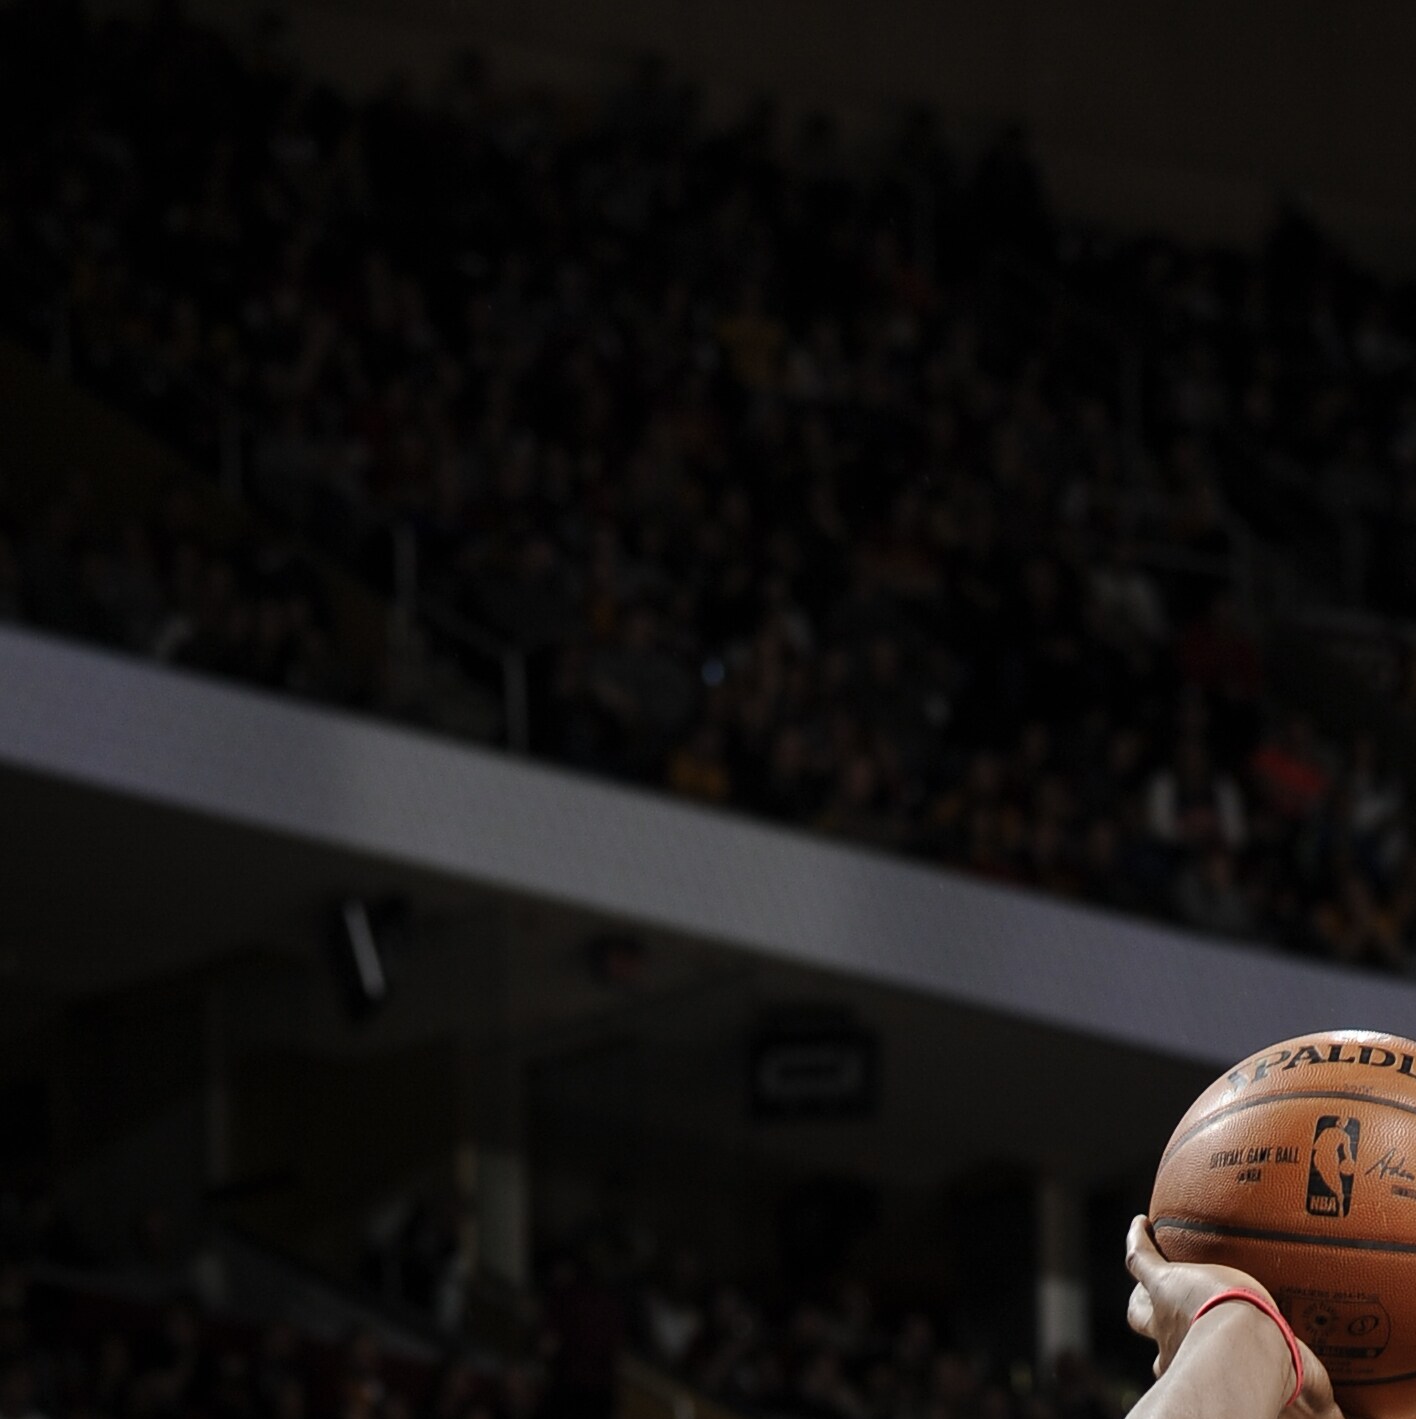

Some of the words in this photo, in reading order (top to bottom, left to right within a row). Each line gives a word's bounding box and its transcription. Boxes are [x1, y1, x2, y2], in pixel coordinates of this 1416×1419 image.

[1247, 1145, 1272, 1165] GAME
[1275, 1144, 1300, 1165] BALL
[1310, 1195, 1337, 1212] NBA
